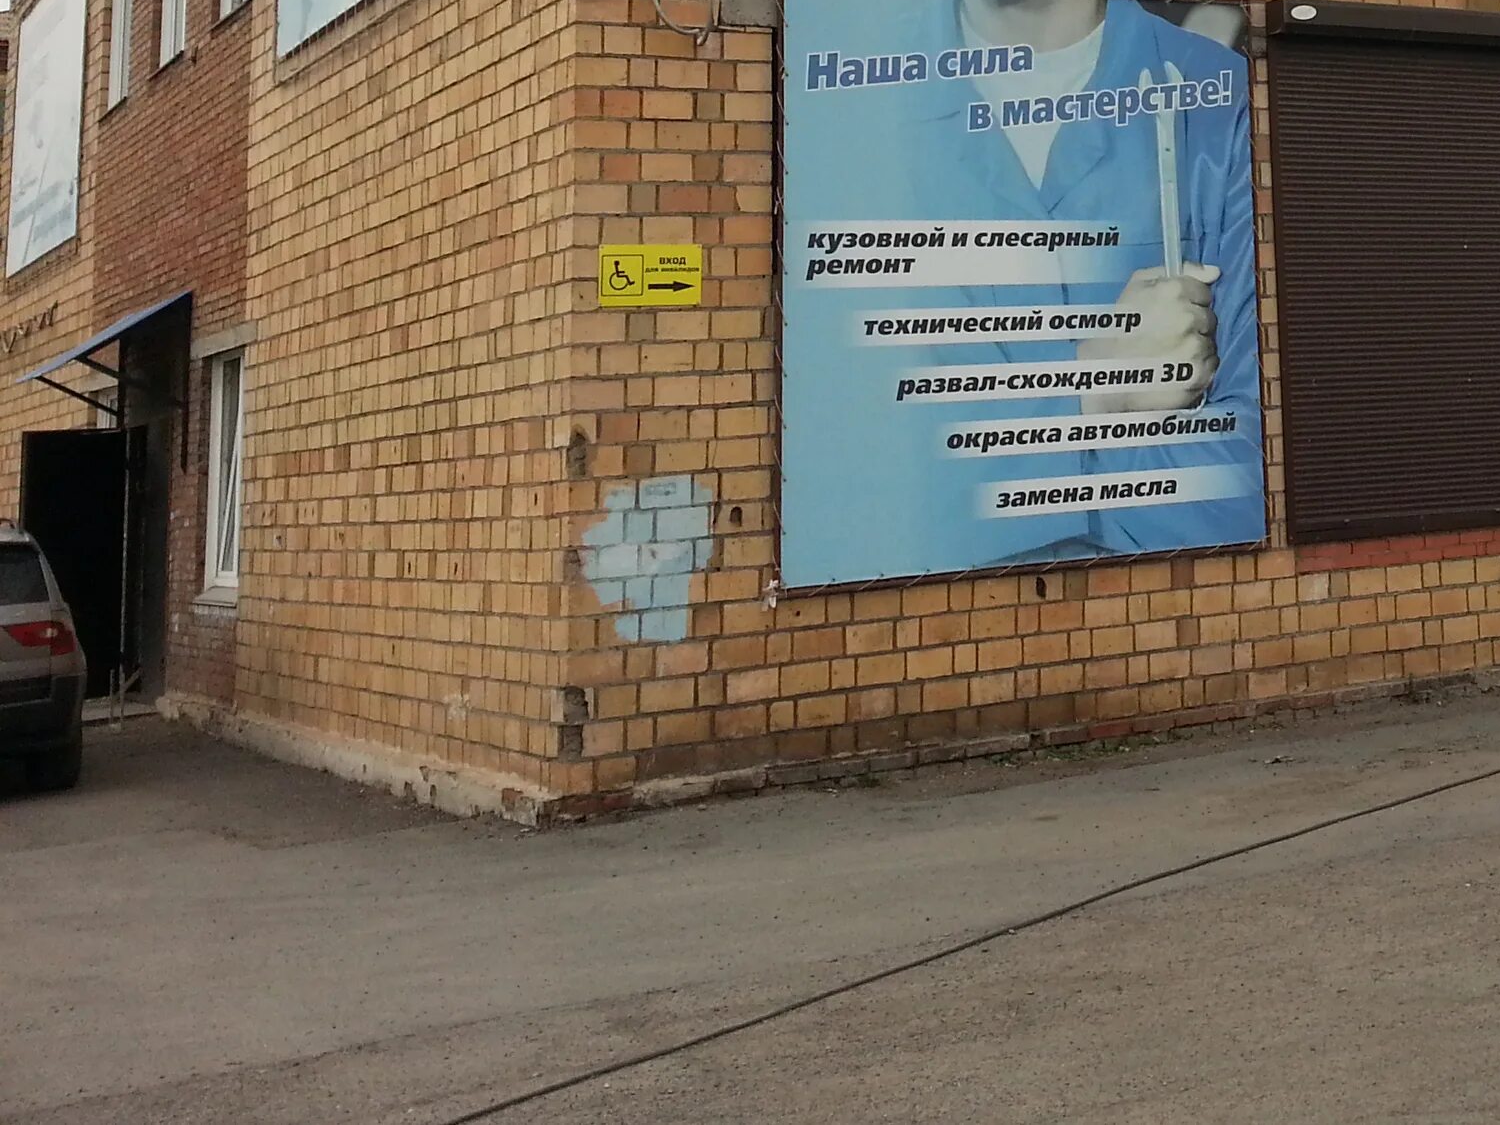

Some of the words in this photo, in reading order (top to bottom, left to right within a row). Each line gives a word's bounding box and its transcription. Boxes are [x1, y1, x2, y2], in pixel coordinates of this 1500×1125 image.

[806, 47, 927, 91] Наша
[937, 43, 1034, 79] сила
[967, 100, 994, 132] в
[1001, 70, 1233, 128] мастерстве!
[806, 227, 945, 254] кузовной
[951, 230, 968, 249] и
[973, 227, 1120, 251] слесарный
[659, 257, 686, 265] ВХОД
[806, 255, 915, 281] ремонт
[863, 310, 1043, 337] технический
[1049, 310, 1142, 336] осмотр
[896, 365, 1154, 401] развал-схождения
[1160, 362, 1194, 382] 3D
[946, 425, 1062, 453] окраска
[1067, 412, 1237, 442] автомобилей
[996, 486, 1094, 510] замена
[1099, 479, 1177, 502] масла
